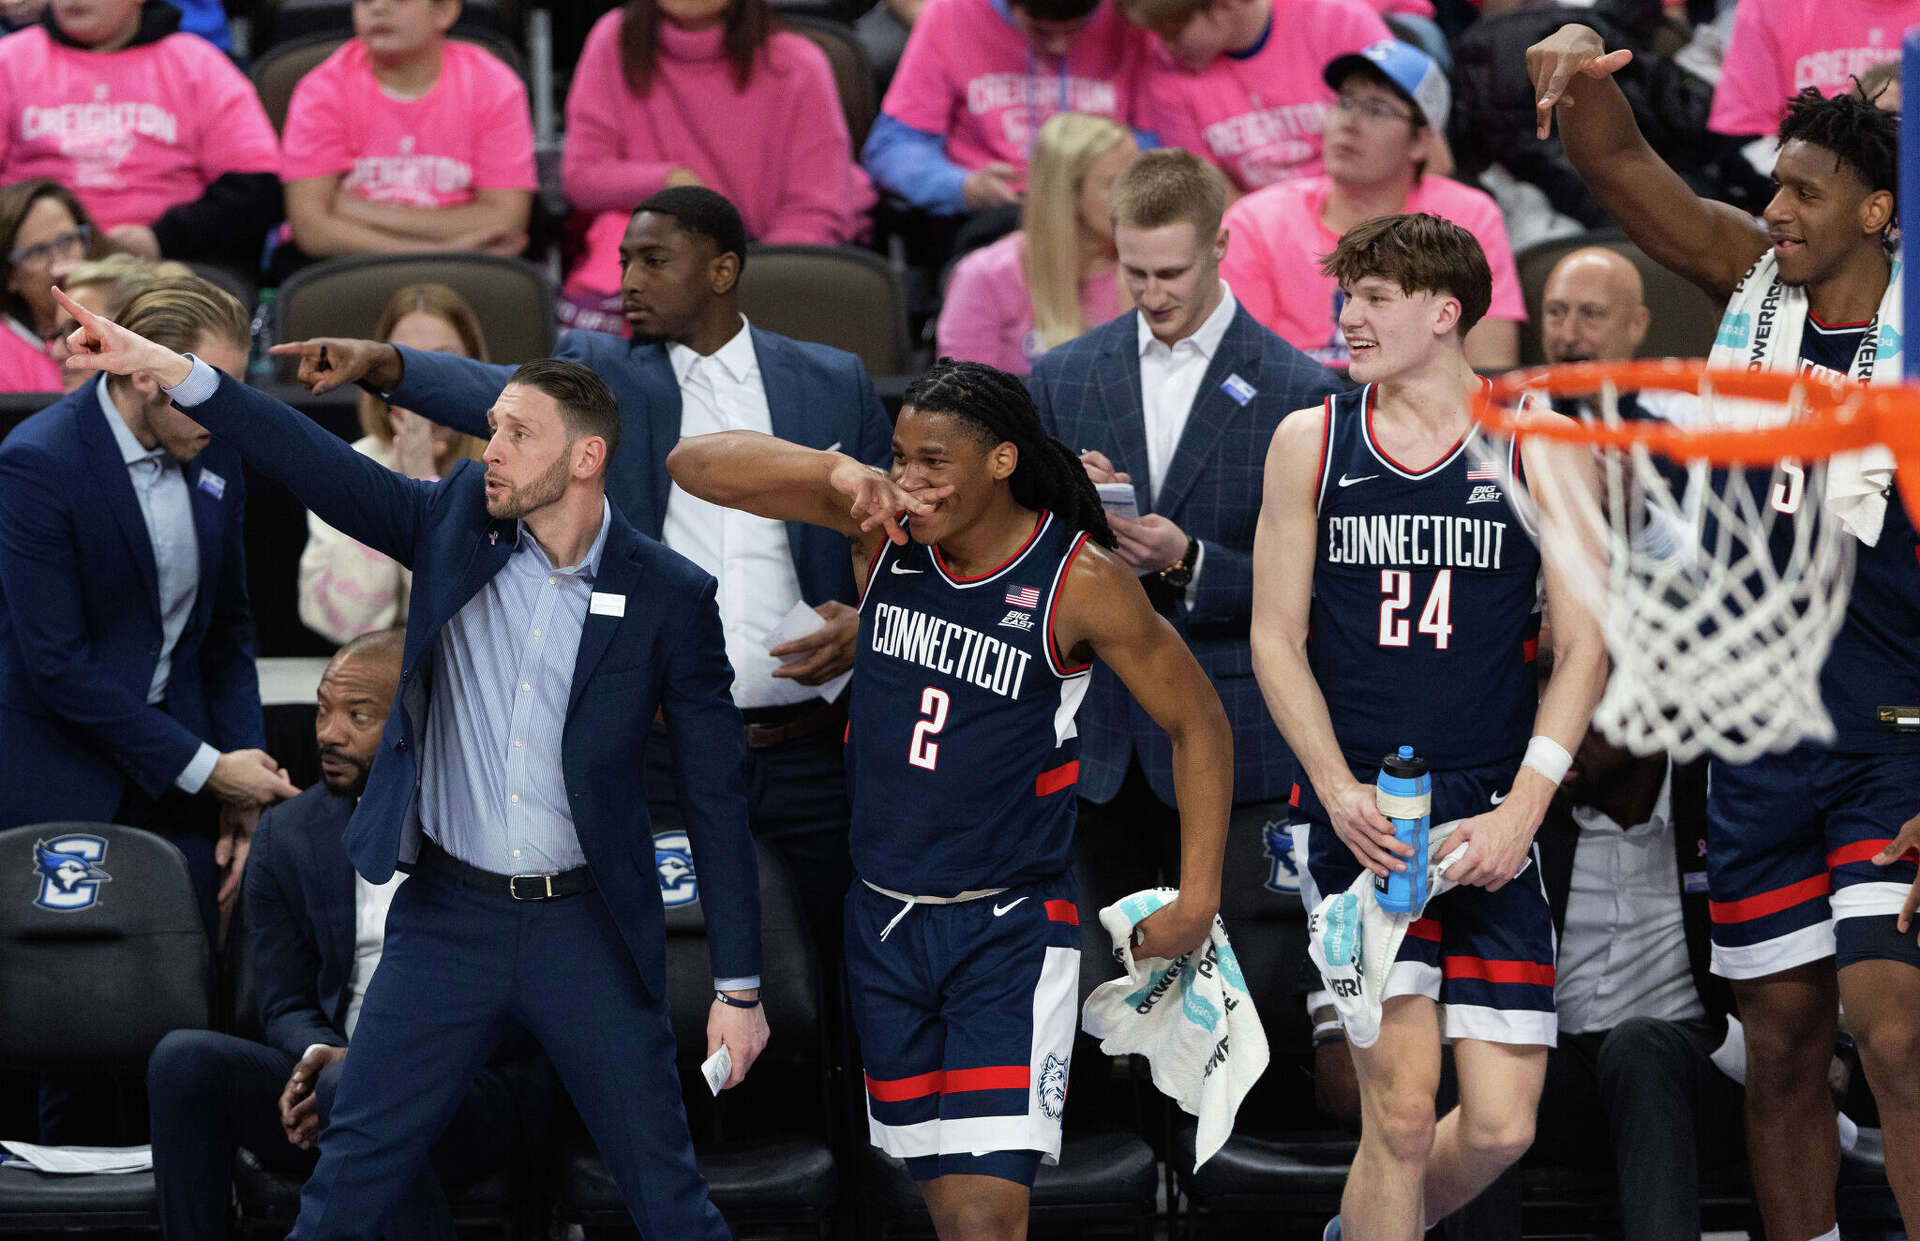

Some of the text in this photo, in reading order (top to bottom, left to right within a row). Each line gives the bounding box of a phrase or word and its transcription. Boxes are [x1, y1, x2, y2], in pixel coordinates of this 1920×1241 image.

[22, 102, 177, 145] CREIGHTON
[1469, 493, 1502, 501] EAST
[1472, 485, 1496, 494] BIG
[1329, 514, 1507, 570] CONNECTICUT
[1001, 617, 1035, 629] EAST
[1006, 610, 1031, 621] BIG
[1379, 568, 1453, 650] 24
[872, 602, 1032, 700] CONNECTICUT
[909, 686, 950, 771] 2
